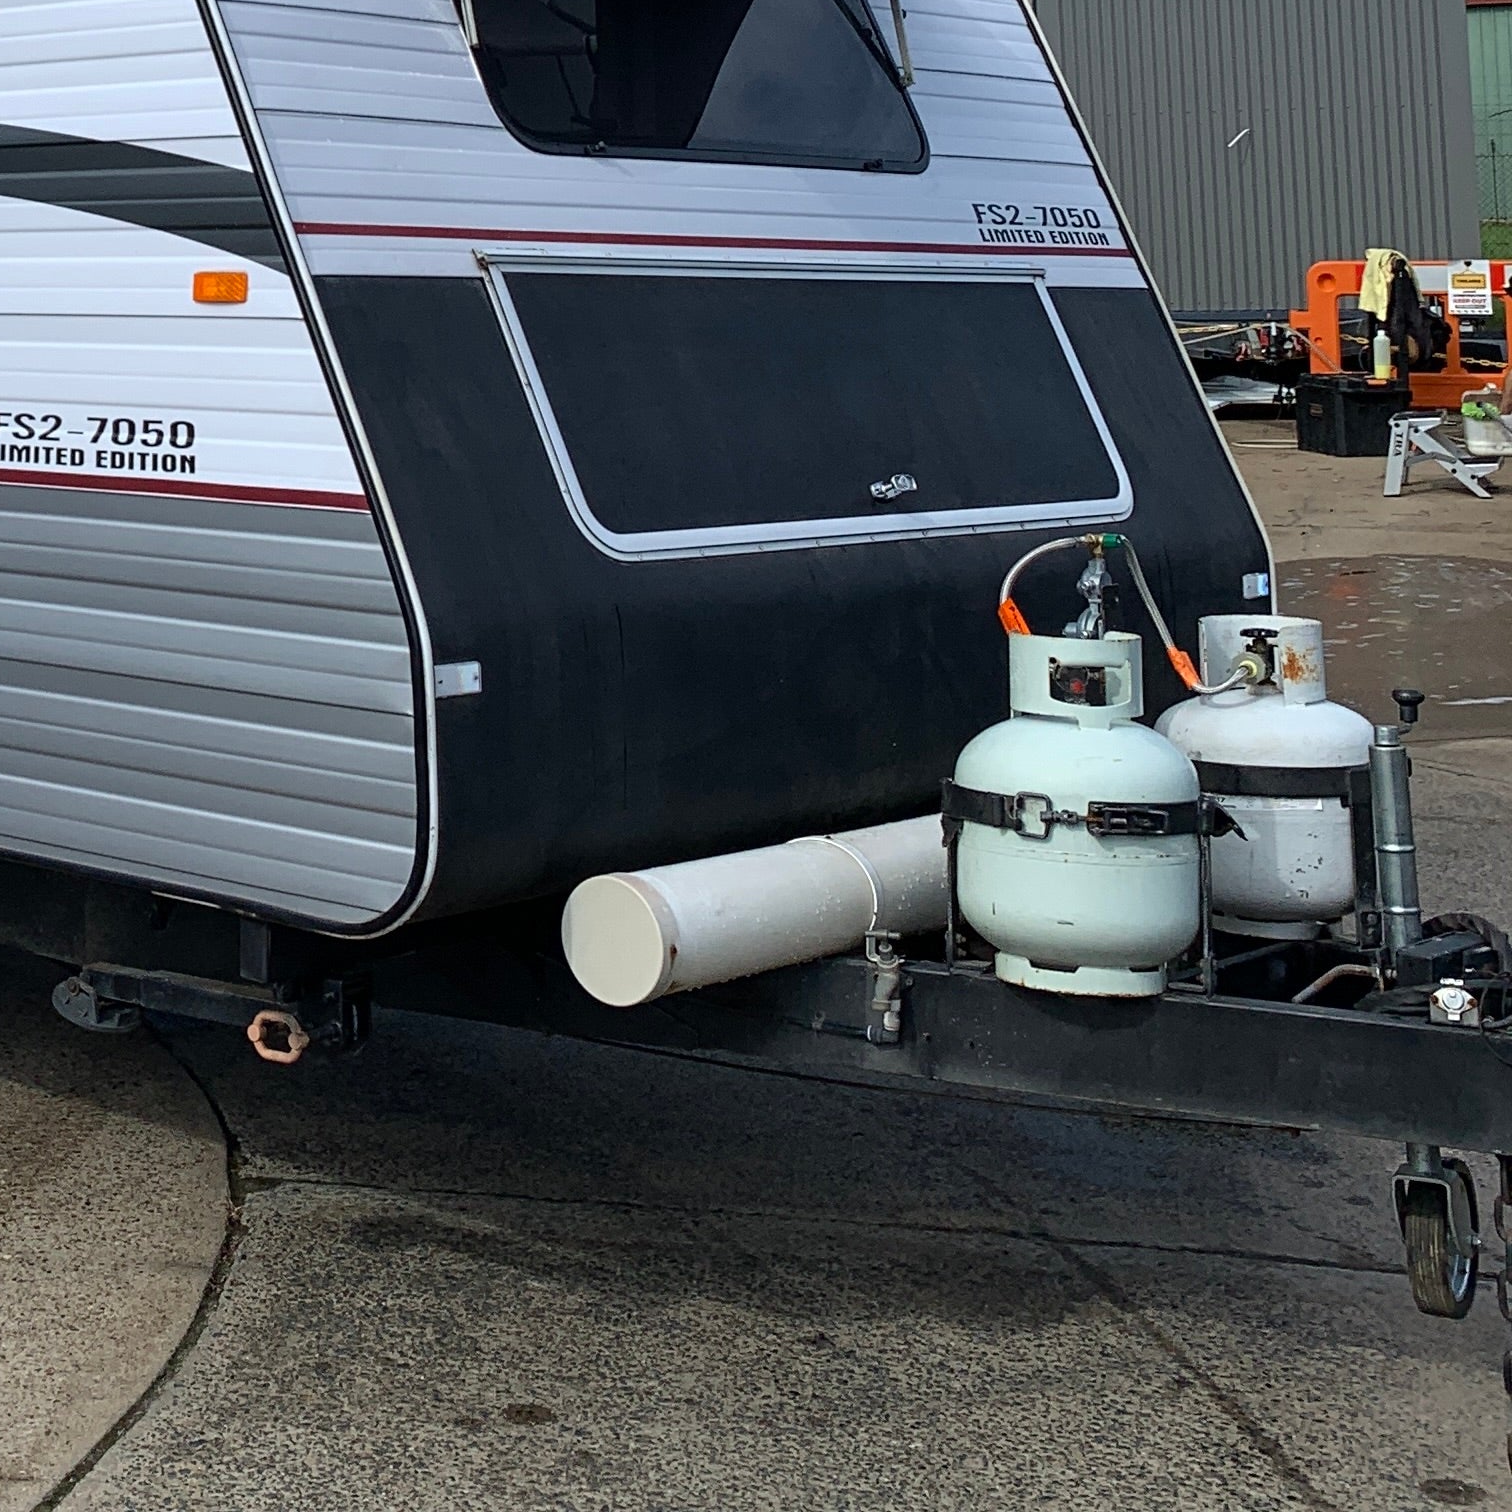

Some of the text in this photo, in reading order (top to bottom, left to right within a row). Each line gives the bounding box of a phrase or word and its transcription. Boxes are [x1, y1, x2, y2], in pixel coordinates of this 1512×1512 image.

[971, 203, 1101, 229] FS2-7050
[978, 228, 1110, 246] LIMITED EDITION
[95, 450, 196, 474] EDITION
